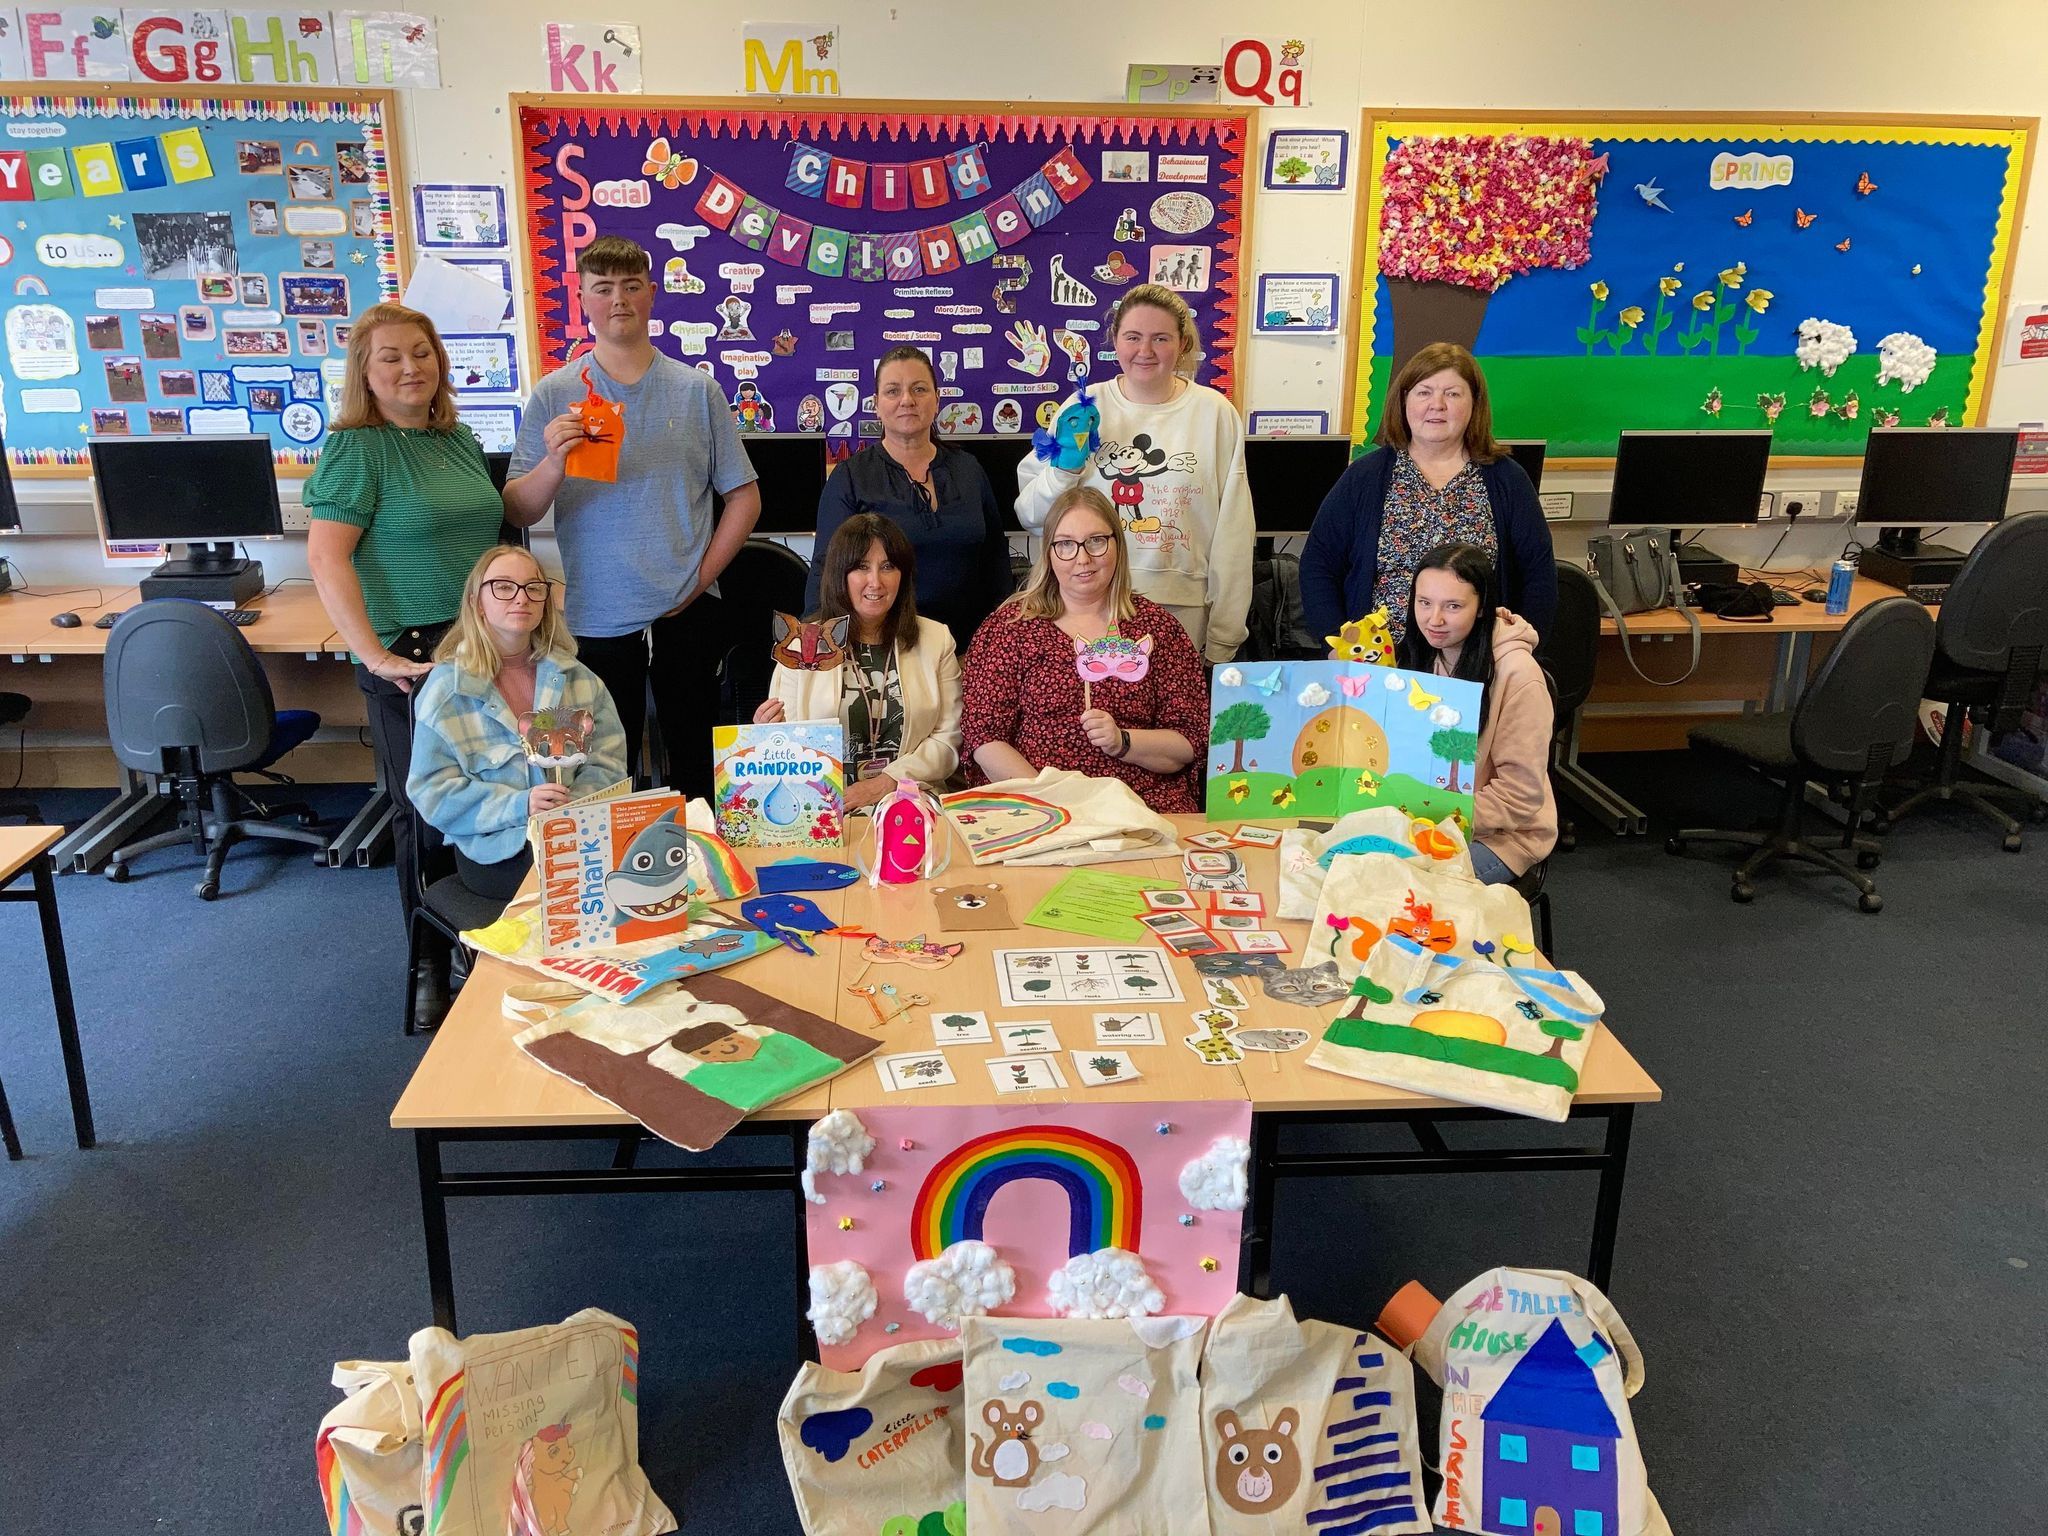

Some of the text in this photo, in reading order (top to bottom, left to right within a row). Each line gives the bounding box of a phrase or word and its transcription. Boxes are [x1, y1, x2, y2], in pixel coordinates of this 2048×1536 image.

[9, 127, 62, 135] stay together
[0, 143, 200, 189] Years
[1160, 157, 1207, 166] Behavioural
[796, 154, 980, 198] Child
[1159, 171, 1207, 182] Development
[1713, 161, 1792, 182] SPRING
[705, 161, 1079, 269] Development
[658, 227, 708, 235] Environmental
[46, 243, 67, 259] to
[722, 266, 761, 276] Creative
[733, 281, 752, 292] play
[894, 287, 952, 296] Primitive Reflexes
[810, 303, 860, 312] Developmental
[935, 306, 982, 314] Moro Startle
[671, 325, 713, 335] Physical
[1067, 321, 1099, 329] Midwife
[884, 332, 940, 340] Rooting Sucking
[683, 341, 704, 353] play
[722, 353, 770, 363] Imaginative
[737, 367, 755, 377] play
[817, 368, 858, 379] Balance
[993, 383, 1057, 393] Fine Motor Skills
[1172, 484, 1203, 498] original
[763, 748, 796, 760] Little
[543, 817, 580, 946] WANTED
[580, 838, 604, 915] Shark
[1449, 1321, 1528, 1355] HOUSE
[468, 1333, 617, 1407] WANTED
